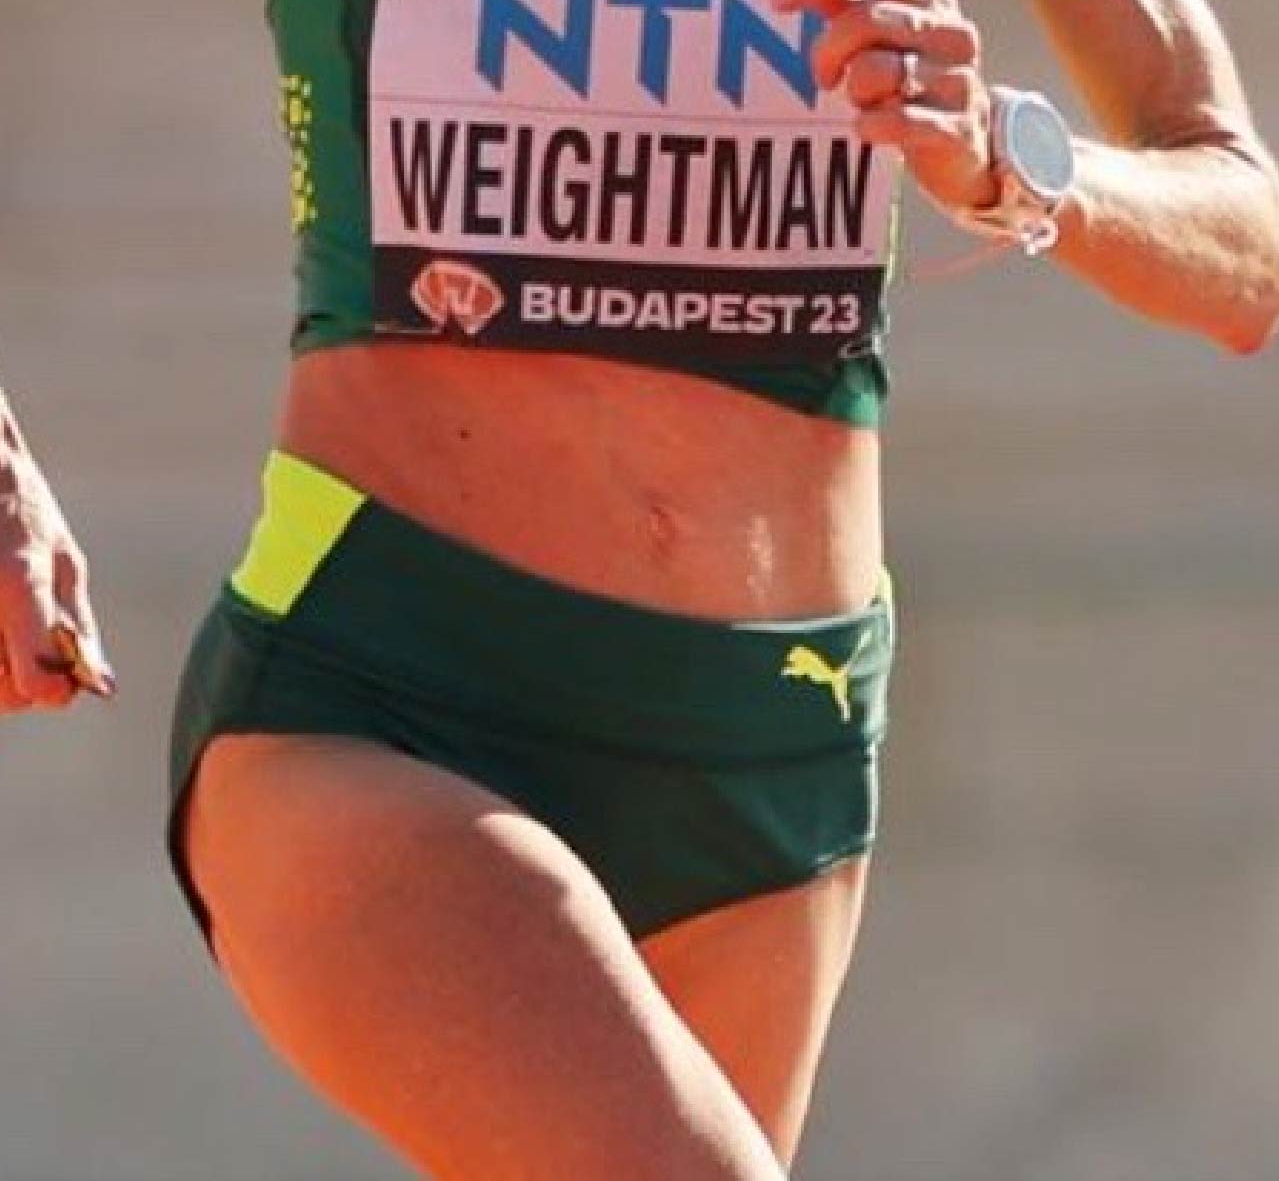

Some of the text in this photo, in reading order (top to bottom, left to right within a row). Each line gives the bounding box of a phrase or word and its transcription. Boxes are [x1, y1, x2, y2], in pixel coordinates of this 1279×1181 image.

[389, 118, 873, 251] WEIGHTMAN
[520, 283, 861, 335] BUDAPEST 23
